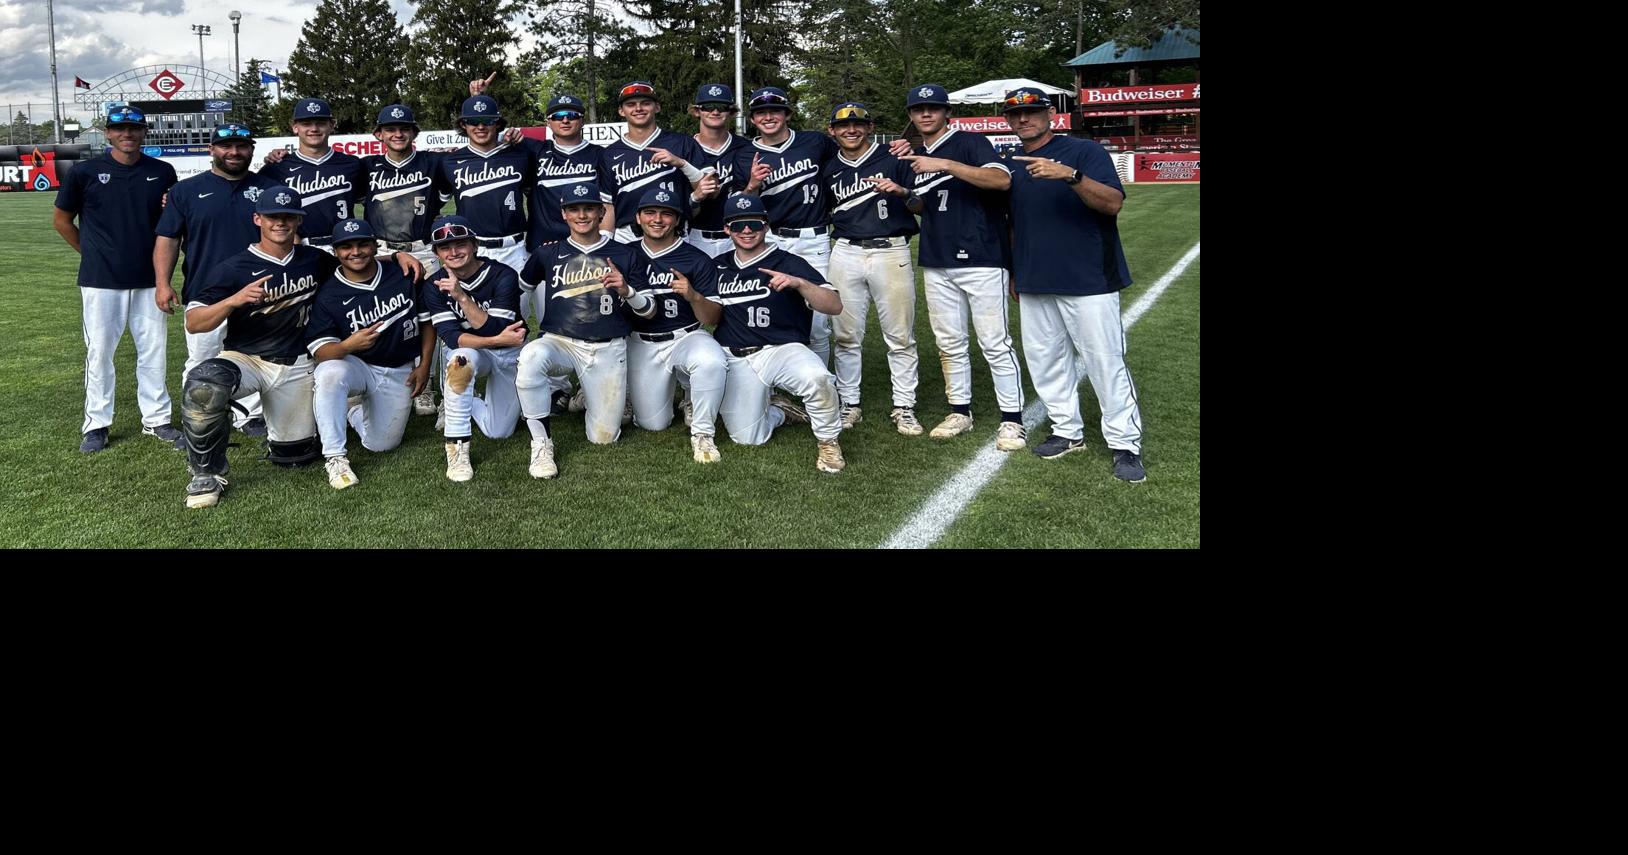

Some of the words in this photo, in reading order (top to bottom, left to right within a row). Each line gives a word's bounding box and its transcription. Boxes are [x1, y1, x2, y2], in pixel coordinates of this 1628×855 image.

[1087, 88, 1185, 103] Budweiser
[947, 119, 1012, 131] dweise
[426, 134, 445, 145] Give
[446, 134, 455, 144] It
[0, 165, 34, 183] RT
[454, 162, 515, 190] Hudson
[537, 158, 594, 177] Hudson
[369, 169, 427, 192] Hudson
[336, 200, 349, 220] 3
[413, 196, 426, 216] 5
[503, 190, 517, 211] 4
[877, 198, 889, 220] 6
[937, 189, 949, 212] 7
[600, 294, 613, 315] 8
[664, 299, 679, 318] 9
[747, 306, 771, 328] 16
[402, 316, 420, 341] 21
